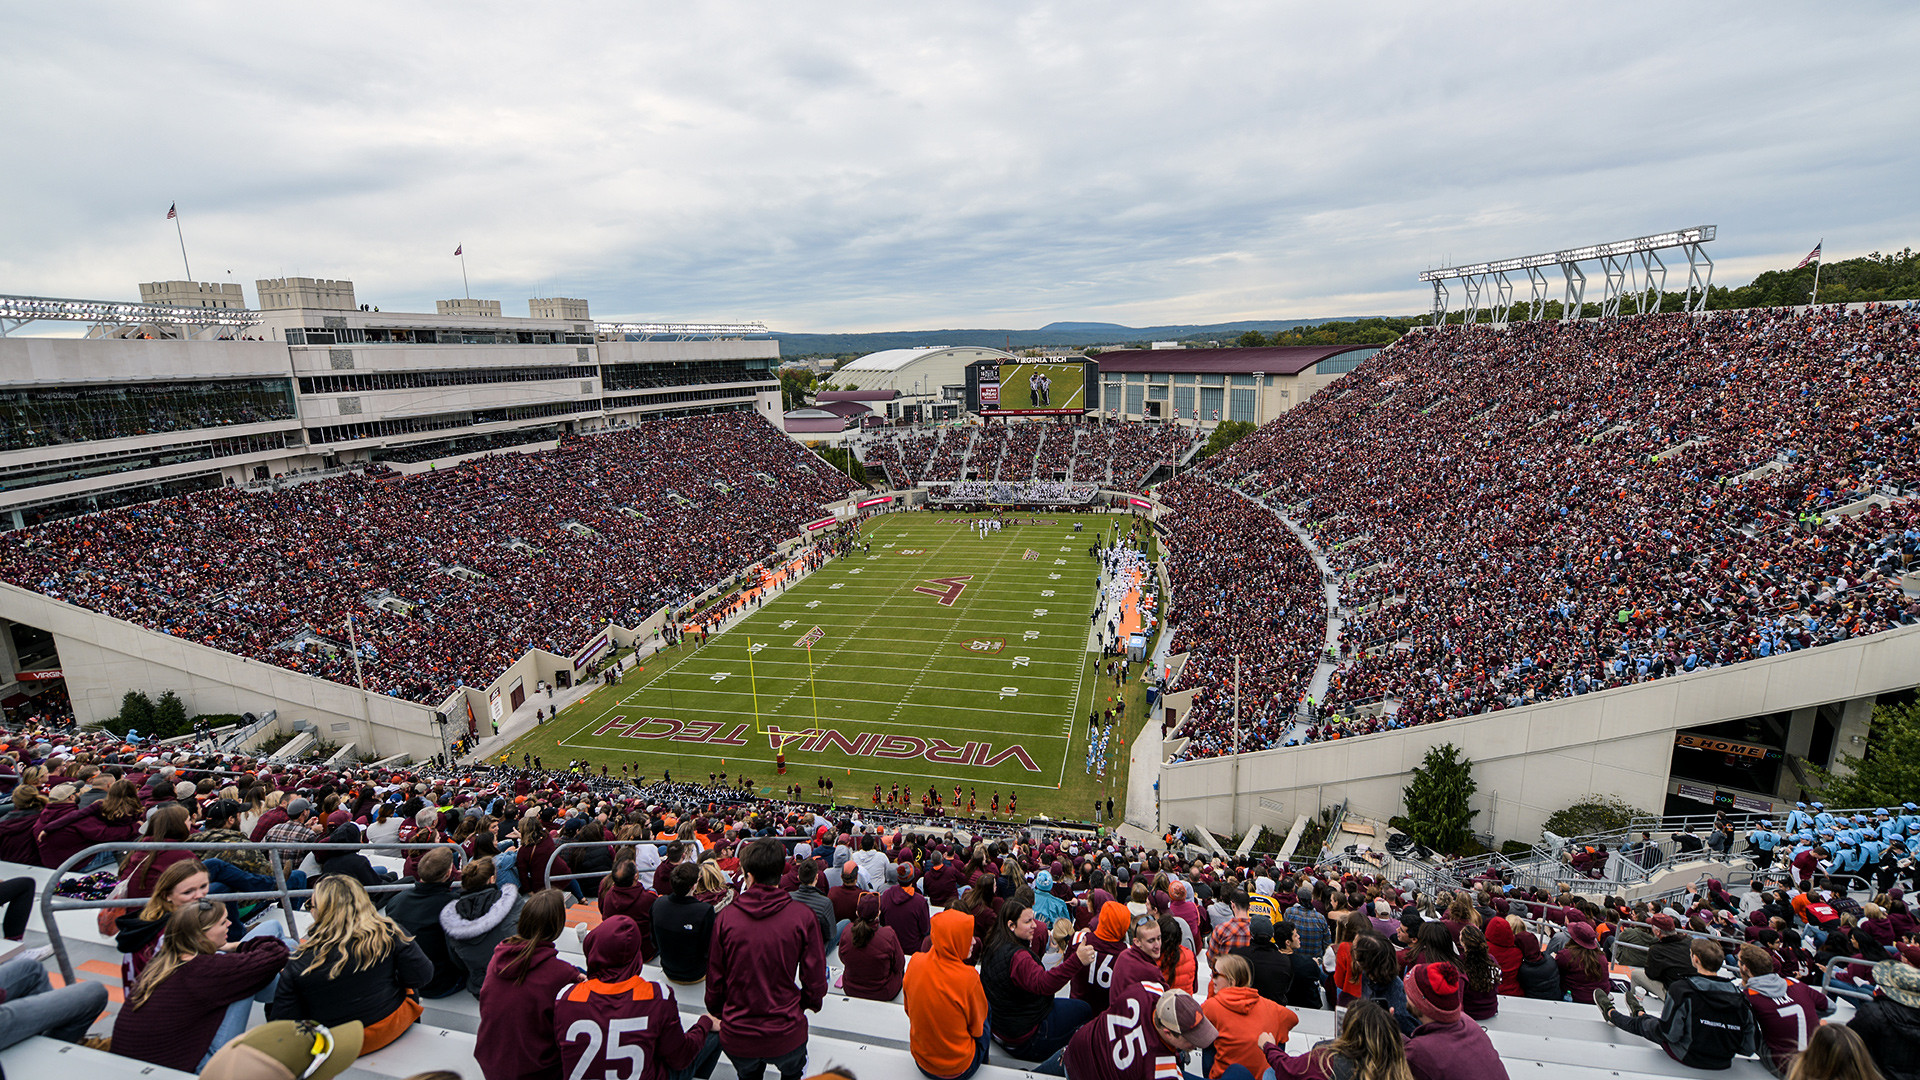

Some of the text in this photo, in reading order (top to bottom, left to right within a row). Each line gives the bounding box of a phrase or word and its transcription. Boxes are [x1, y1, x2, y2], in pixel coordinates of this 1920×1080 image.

[1012, 656, 1030, 667] 20
[999, 686, 1019, 697] 10
[591, 714, 1042, 773] VIRGINIA TECH
[1700, 740, 1760, 756] HOME
[1087, 950, 1114, 989] 16
[1106, 997, 1148, 1071] 25
[1700, 1018, 1726, 1029] VIRGINIA
[1776, 1003, 1808, 1052] 7
[565, 1015, 649, 1080] 25
